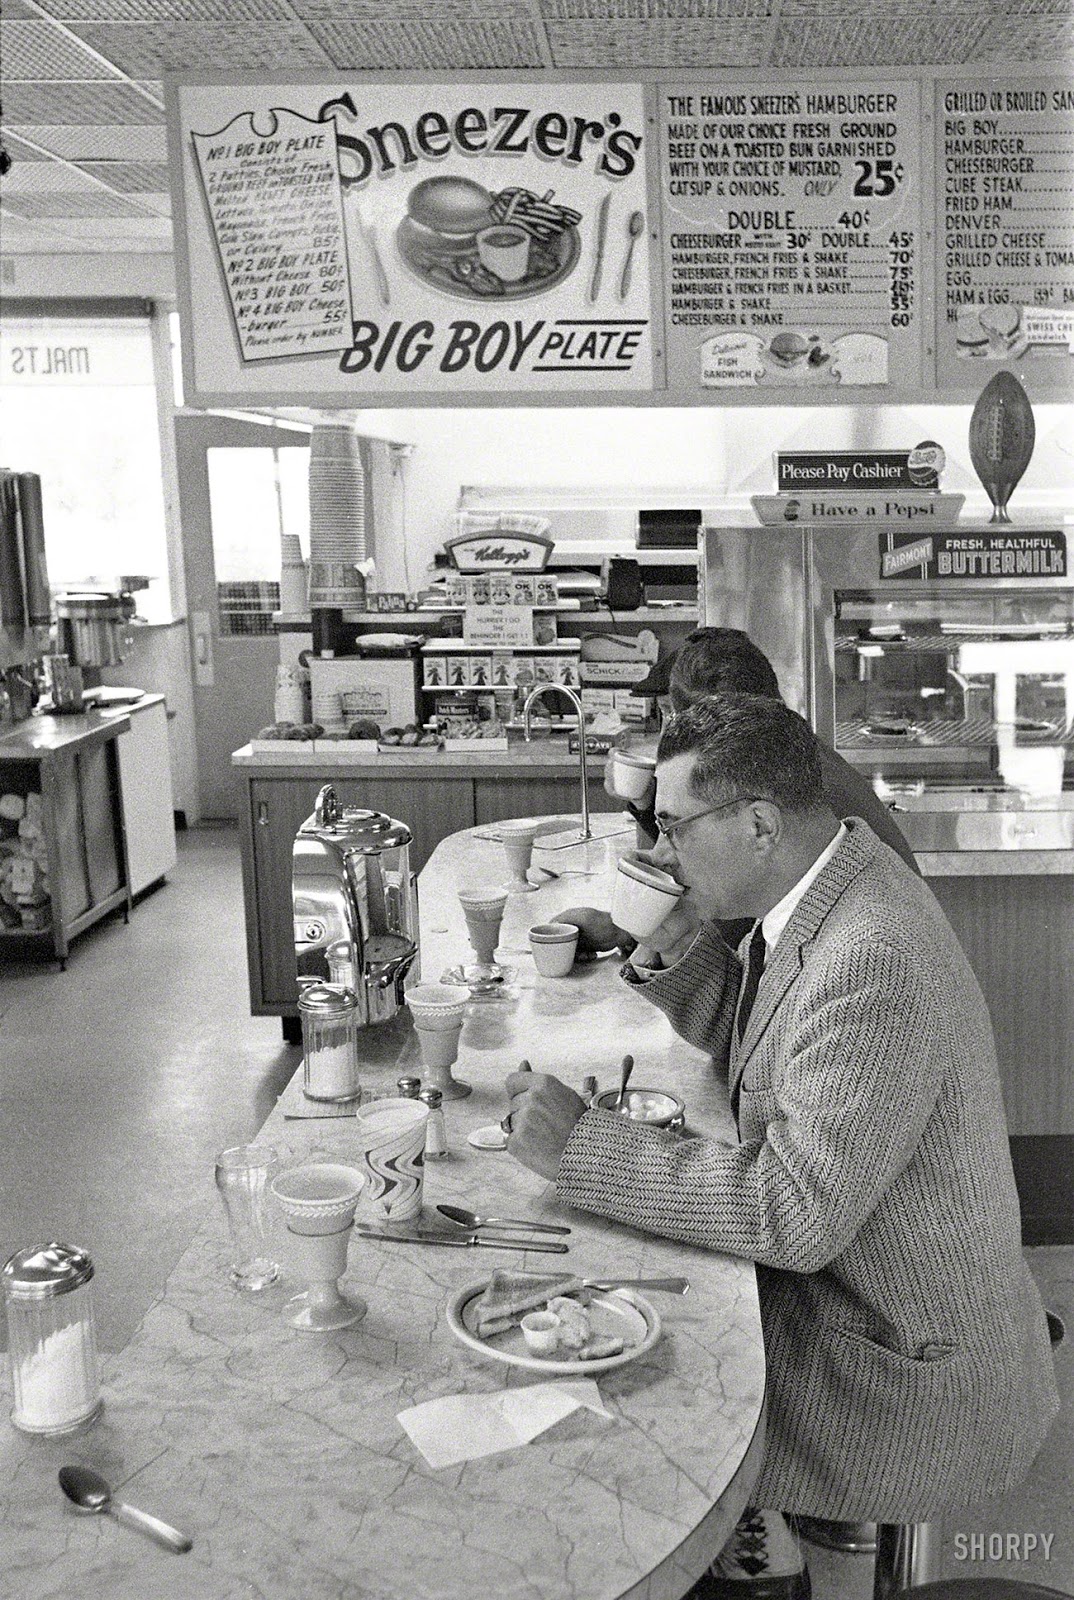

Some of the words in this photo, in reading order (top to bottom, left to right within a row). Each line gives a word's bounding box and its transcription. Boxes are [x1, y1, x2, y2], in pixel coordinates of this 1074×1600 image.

[668, 97, 694, 116] THE
[701, 96, 747, 116] FAMOUS
[751, 92, 800, 115] SNEEZER'S
[807, 94, 898, 115] HAMBURGER
[945, 92, 987, 112] GRILLED
[1006, 91, 1047, 111] BROILED
[668, 124, 699, 140] MADE
[703, 124, 717, 139] OF
[719, 123, 744, 139] OUR
[749, 123, 786, 139] CHOICE
[793, 123, 831, 138] FRESH
[840, 122, 897, 138] GROUND
[945, 121, 966, 135] BIG
[974, 120, 999, 135] BOY
[235, 141, 256, 157] BIG
[258, 140, 282, 155] BOY
[285, 135, 325, 151] PLATE
[318, 92, 642, 187] Sneezer's
[945, 139, 1024, 155] HAMBURGER
[668, 143, 696, 158] BEEF
[701, 143, 719, 158] ON
[721, 143, 730, 157] A
[734, 142, 785, 157] TOASTED
[789, 142, 813, 157] BUN
[818, 142, 896, 157] GARNISHED
[669, 161, 699, 177] WITH
[702, 161, 729, 176] YOUR
[733, 161, 770, 177] CHOICE
[772, 161, 786, 176] OF
[789, 161, 842, 178] MUSTARD,
[945, 158, 1034, 173] CHEESEBURGER
[669, 181, 712, 196] CATSUP
[716, 181, 725, 195] &
[804, 180, 838, 197] ONLY
[945, 177, 976, 193] CUBE
[983, 177, 1023, 192] STEAK
[945, 197, 979, 211] FRIED
[984, 196, 1012, 210] HAM
[728, 211, 796, 230] DOUBLE
[945, 215, 1001, 230] DENVER
[670, 233, 742, 249] CHEESEBURGER
[821, 233, 870, 248] DOUBLE
[945, 233, 998, 249] GRILLED
[1002, 233, 1046, 248] CHEESE
[257, 257, 277, 270] BIG
[278, 255, 299, 268] BOY
[302, 250, 339, 265] PLATE
[734, 252, 769, 264] FRENCH
[773, 252, 798, 264] FRIES
[803, 252, 809, 264] &
[814, 252, 849, 264] SHAKE
[946, 252, 991, 268] GRILLED
[996, 252, 1031, 267] CHEESE
[1035, 253, 1042, 267] &
[735, 267, 770, 279] FRENCH
[773, 267, 798, 279] FRIES
[803, 267, 810, 278] &
[815, 266, 849, 278] SHAKE
[946, 271, 972, 286] EGG
[265, 286, 286, 298] BIG
[289, 282, 314, 296] BOY
[672, 283, 723, 295] HAMBURGER
[726, 283, 732, 294] &
[735, 283, 765, 294] FRENCH
[767, 283, 790, 294] FRIES
[793, 283, 804, 294] IN
[806, 283, 813, 293] A
[817, 283, 851, 294] BASKET
[947, 289, 975, 305] HAM
[987, 289, 1010, 304] EGG
[264, 302, 283, 315] BIG
[284, 300, 305, 313] BOY
[672, 298, 724, 310] HAMBURGER
[729, 299, 735, 310] &
[741, 298, 771, 310] SHAKE
[672, 313, 737, 325] CHEESEBURGER
[751, 313, 783, 325] SHAKE
[338, 320, 435, 373] BIG
[440, 320, 546, 373] BOY
[539, 331, 643, 359] PLATE
[718, 358, 738, 366] FISH
[704, 370, 752, 378] SANDWICH
[782, 463, 825, 480] Please
[827, 463, 850, 482] Pay
[853, 462, 904, 478] Cashier
[811, 503, 858, 516] Have
[866, 506, 876, 516] a
[885, 503, 935, 518] Pepsi
[946, 539, 987, 552] FRESH,
[991, 538, 1056, 549] HEALTHFUL
[475, 545, 530, 565] Kellogg's
[885, 542, 933, 573] FAIRMONT
[938, 550, 1064, 575] BUTTERMILK
[587, 667, 621, 675] SCHICK
